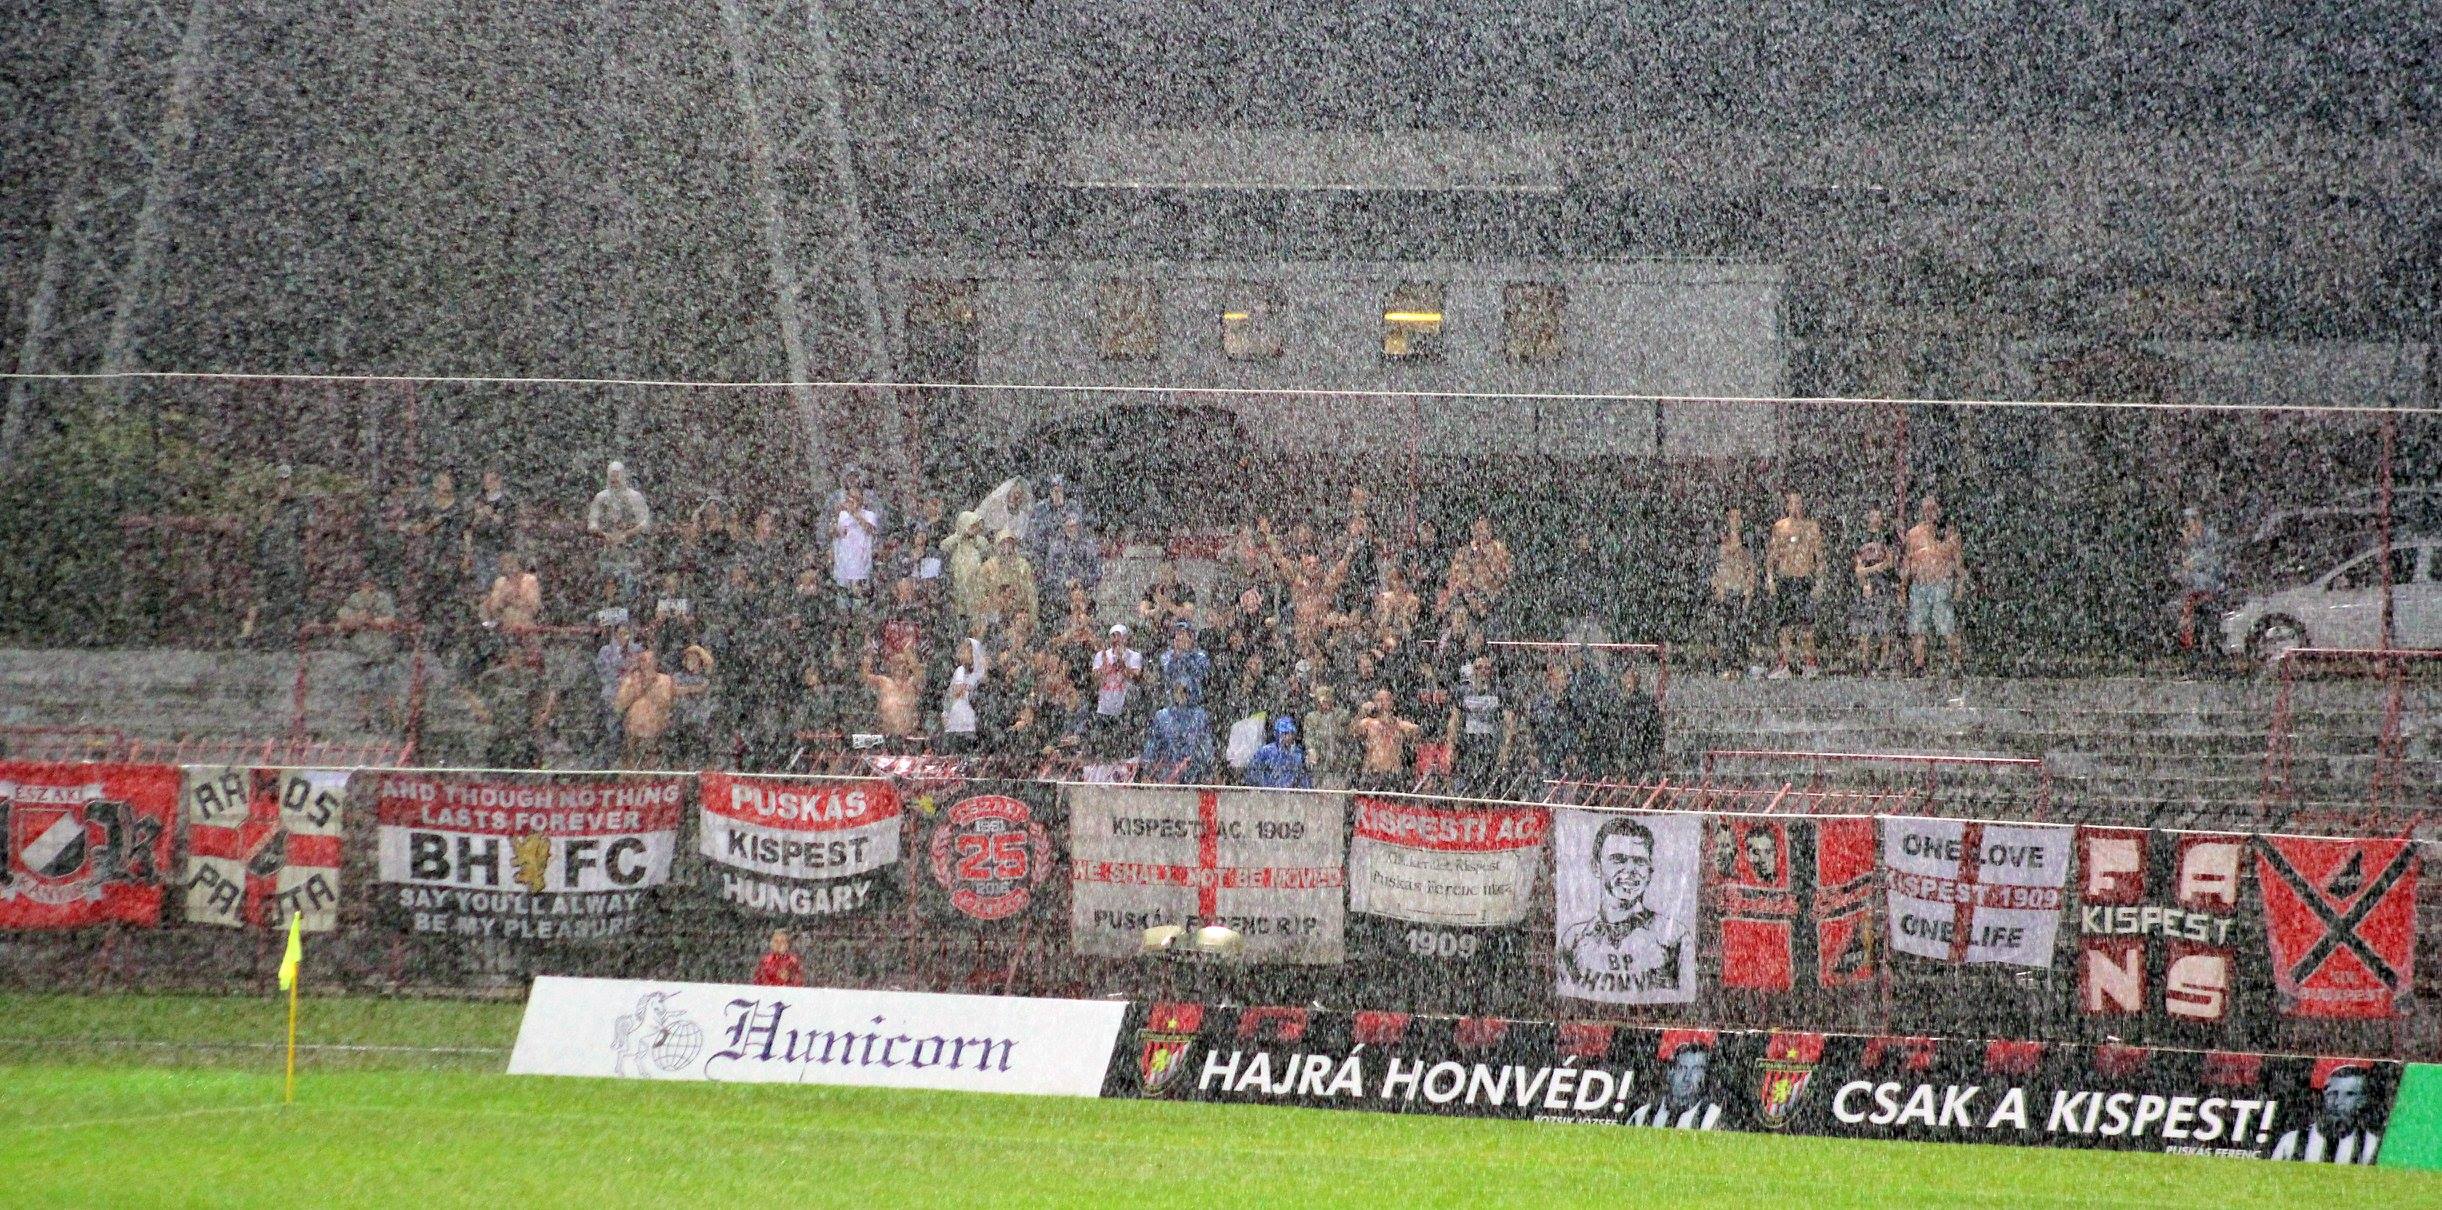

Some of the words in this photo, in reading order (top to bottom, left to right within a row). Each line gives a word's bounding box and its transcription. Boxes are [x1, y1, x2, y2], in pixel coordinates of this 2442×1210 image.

[381, 780, 436, 801] AND
[445, 784, 551, 808] THOUGH
[559, 784, 680, 807] NOTHING
[731, 783, 868, 822] PUSKÁS
[421, 804, 508, 828] LASTS
[515, 811, 641, 831] FOREVER
[1255, 820, 1305, 840] 1909
[1355, 802, 1487, 843] KISPESTI
[409, 832, 500, 886] BH
[564, 838, 647, 887] FC
[728, 829, 870, 869] KISPEST
[955, 831, 1028, 880] 25
[1903, 834, 1962, 861] ONE
[723, 872, 872, 914] HUNGARY
[1187, 867, 1225, 887] NOT
[1236, 867, 1264, 888] BE
[1885, 871, 1990, 905] KISPEST
[2000, 886, 2059, 908] 1909
[400, 888, 449, 907] SAY
[414, 912, 449, 933] BE
[457, 916, 497, 936] MY
[1902, 913, 1956, 942] ONE
[2081, 906, 2237, 946] KISPEST
[1407, 929, 1477, 958] 1909
[704, 999, 1020, 1081] Hunicorn
[1198, 1044, 1365, 1099] HAJRÁ
[1380, 1056, 1635, 1114] HONVÉD!
[1832, 1080, 1982, 1127] CSAK
[1985, 1088, 2029, 1130] A
[2047, 1090, 2278, 1145] KISPEST!
